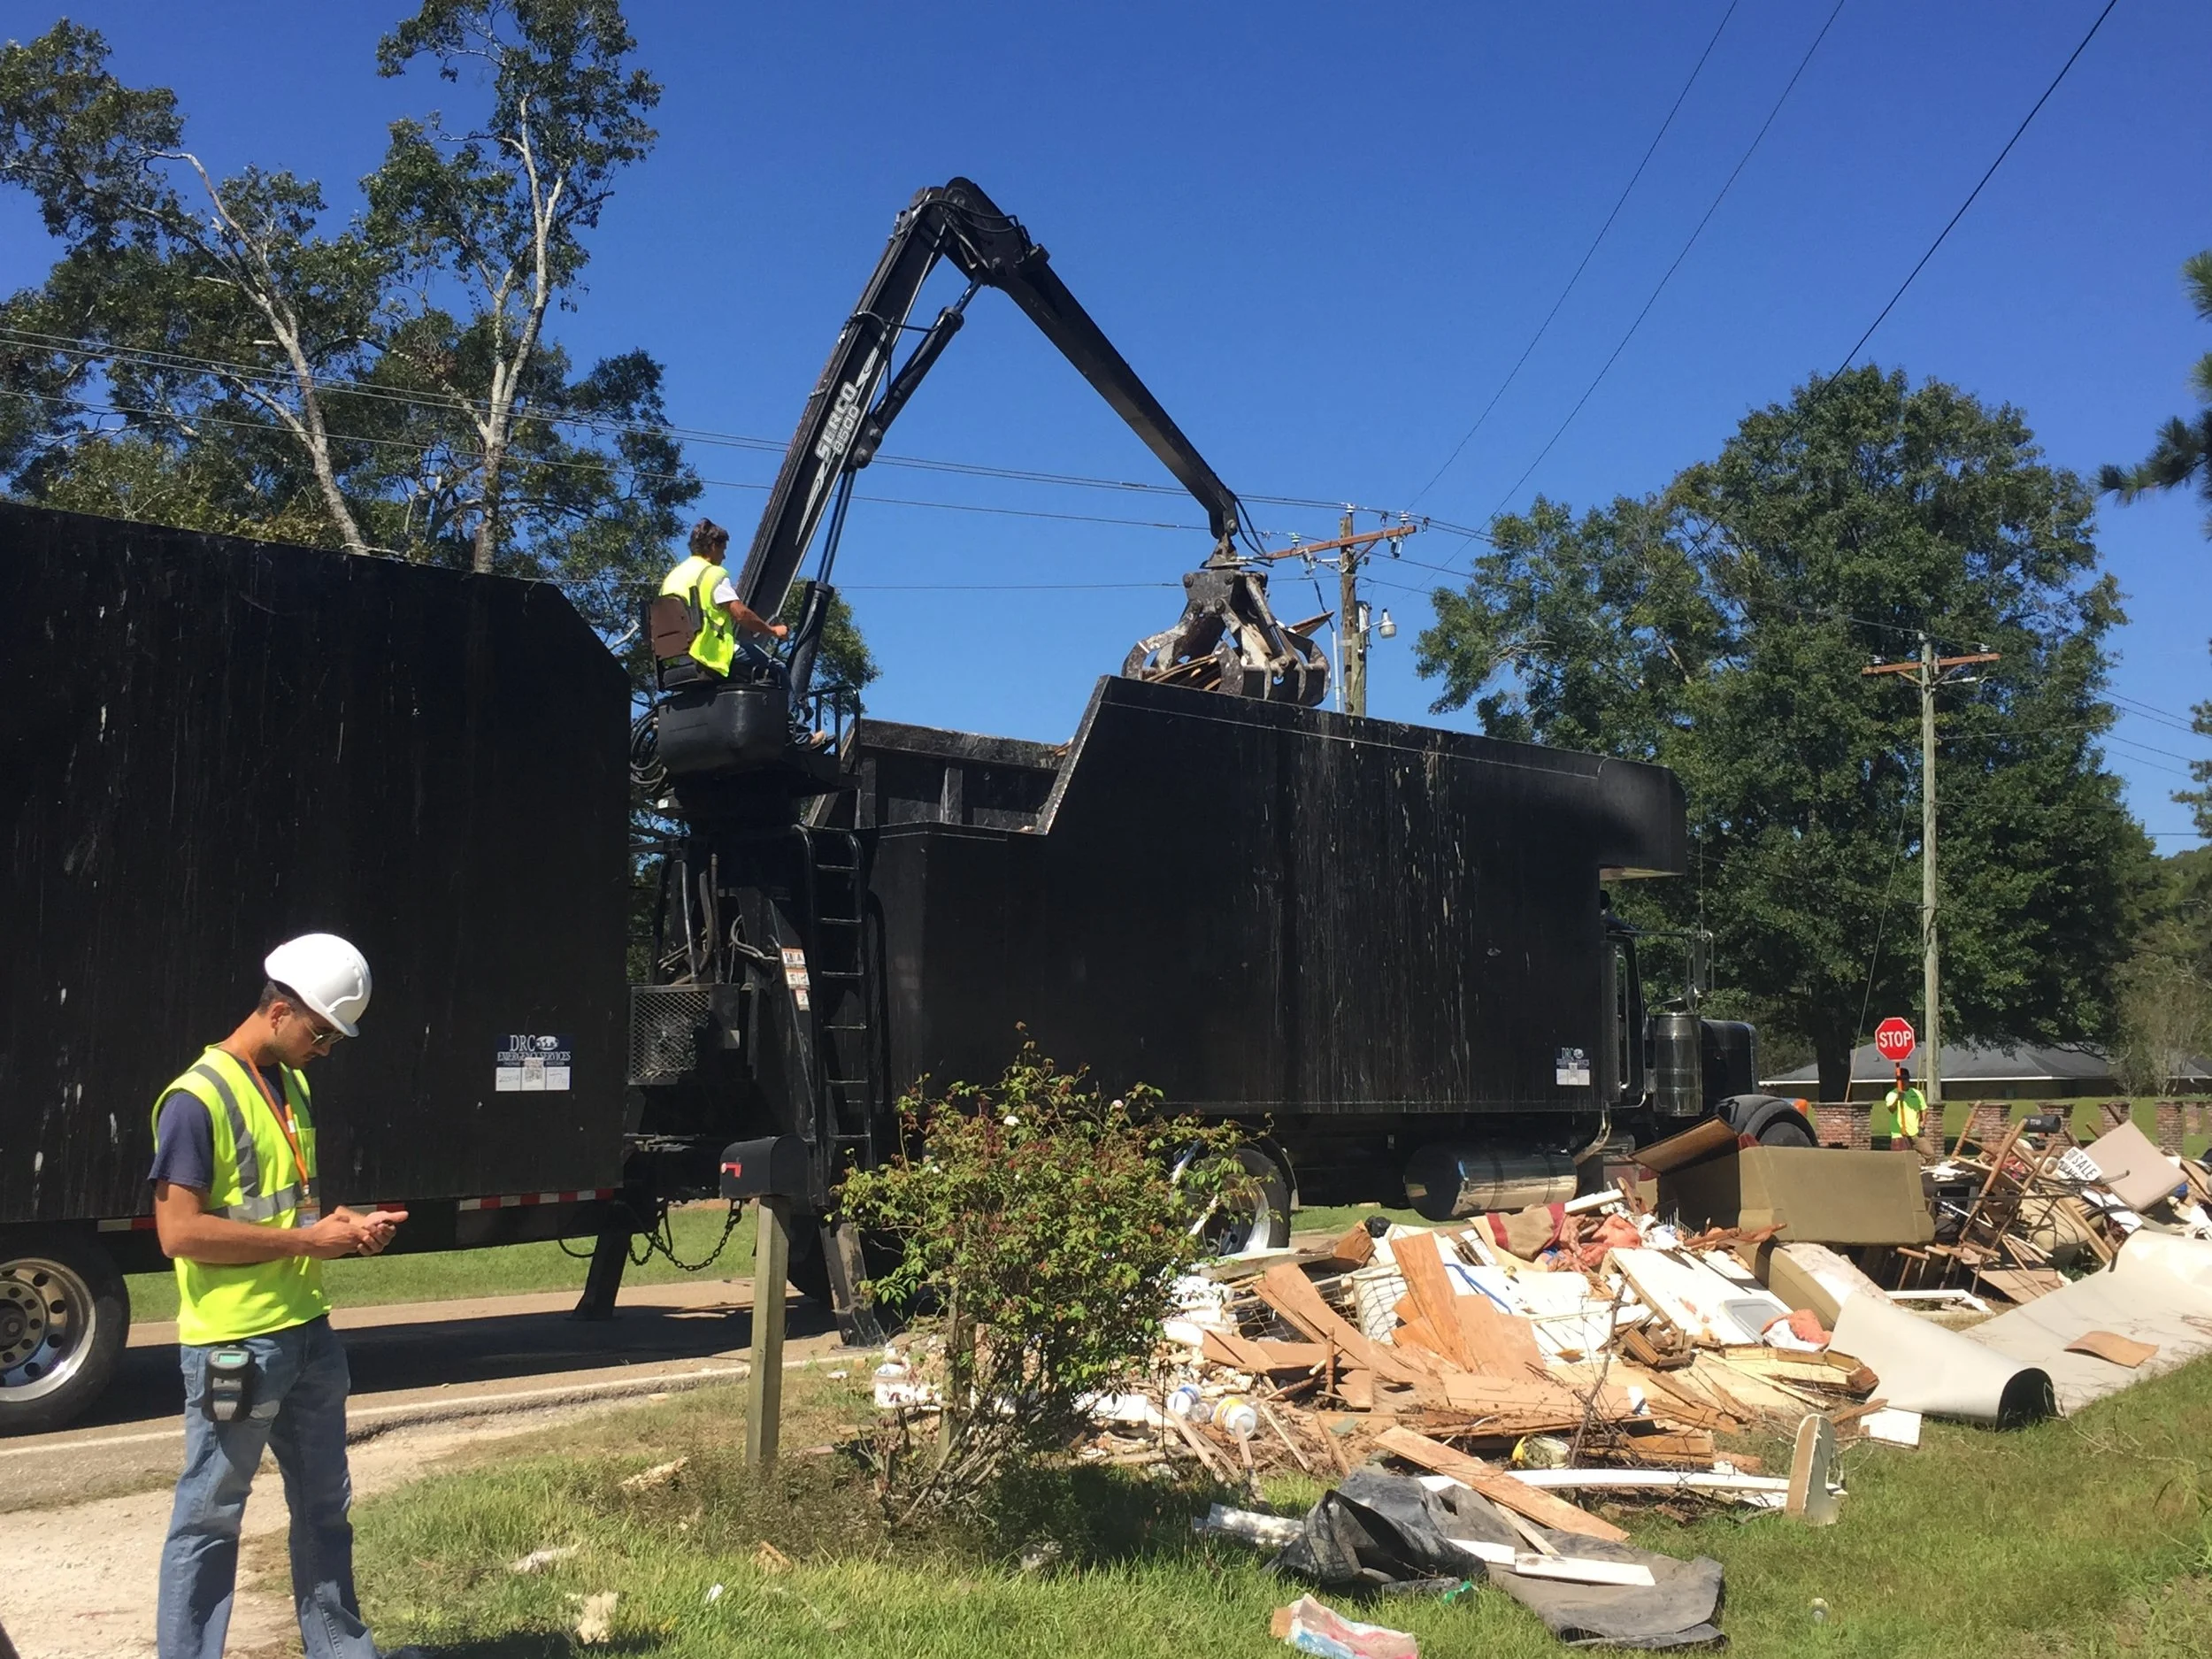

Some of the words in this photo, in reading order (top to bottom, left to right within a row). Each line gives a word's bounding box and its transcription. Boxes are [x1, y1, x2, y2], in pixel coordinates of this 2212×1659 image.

[815, 382, 858, 463] SERCO
[833, 404, 860, 455] 8500
[509, 1034, 536, 1052] DRC
[1878, 1031, 1912, 1048] STOP
[2071, 1155, 2098, 1179] SALE
